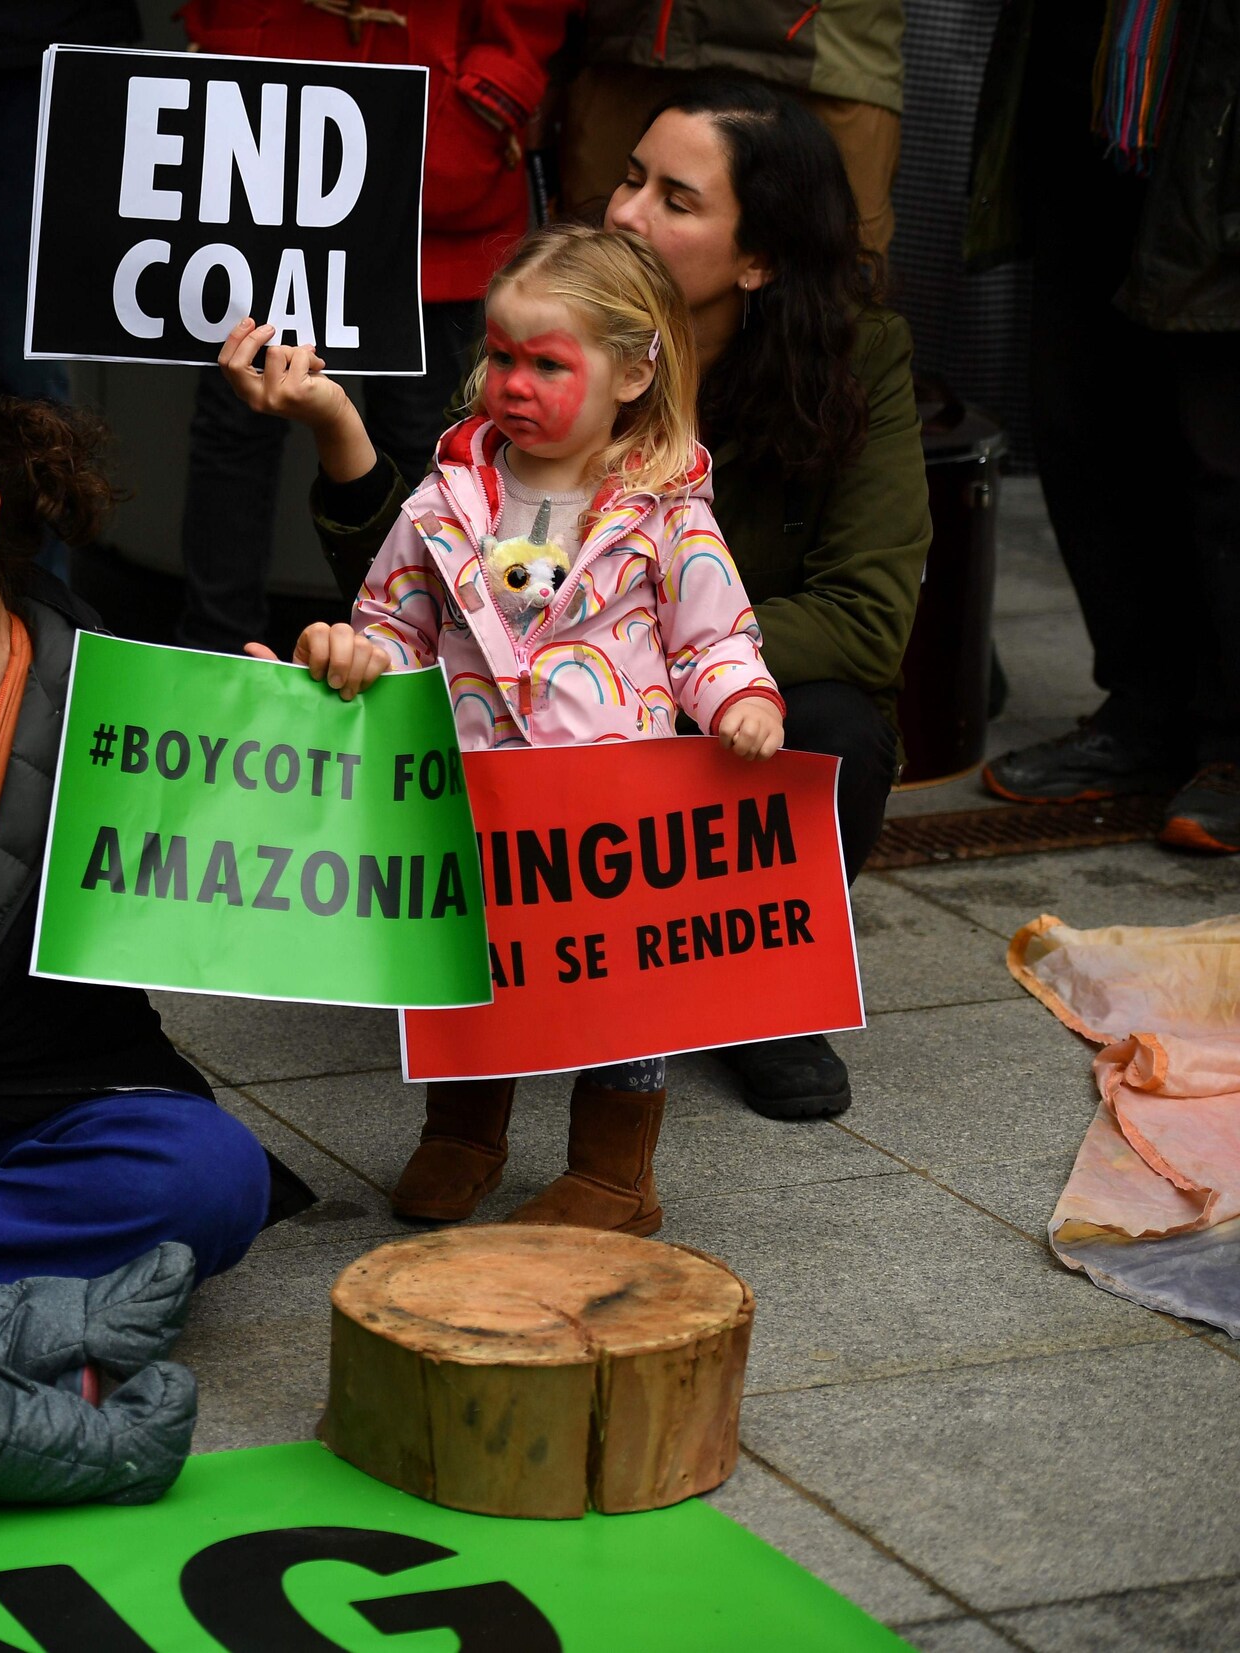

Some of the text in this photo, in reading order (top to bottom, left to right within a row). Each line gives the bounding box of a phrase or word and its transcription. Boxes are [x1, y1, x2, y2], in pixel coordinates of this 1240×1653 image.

[118, 76, 368, 228] END
[113, 238, 360, 348] COAL
[89, 723, 463, 802] #BOYCOTT FOR
[80, 825, 469, 920] AMAZONIA
[476, 792, 797, 907] INGUEM
[555, 933, 609, 984] SE
[636, 898, 816, 971] RENDER
